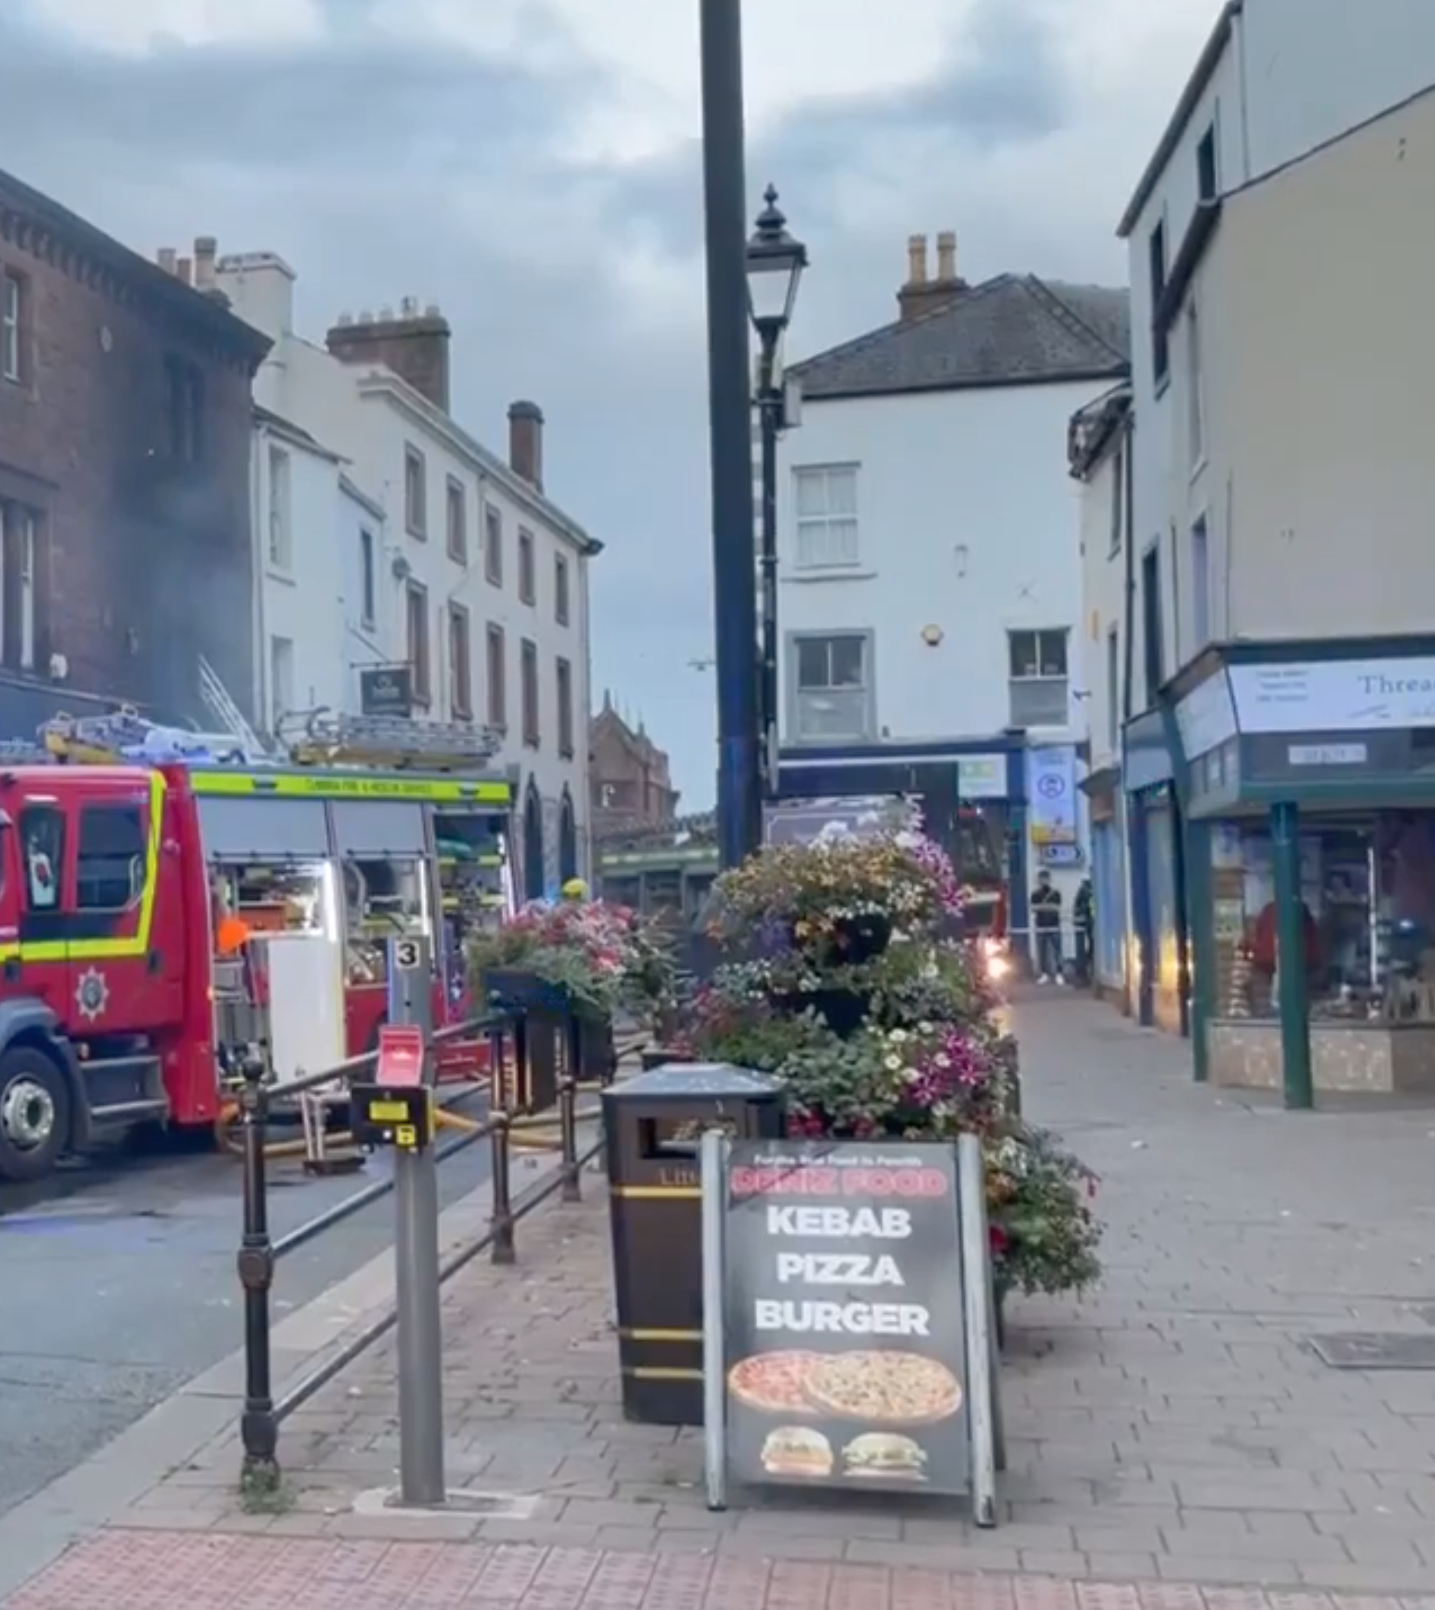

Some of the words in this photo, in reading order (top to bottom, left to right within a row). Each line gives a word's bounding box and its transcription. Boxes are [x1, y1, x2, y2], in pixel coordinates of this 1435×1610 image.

[1356, 672, 1435, 695] Threa
[397, 943, 417, 966] 3
[842, 1168, 946, 1196] FOOD
[766, 1205, 913, 1238] KEBAB
[776, 1253, 904, 1286] PIZZA
[754, 1298, 931, 1336] BURGER
